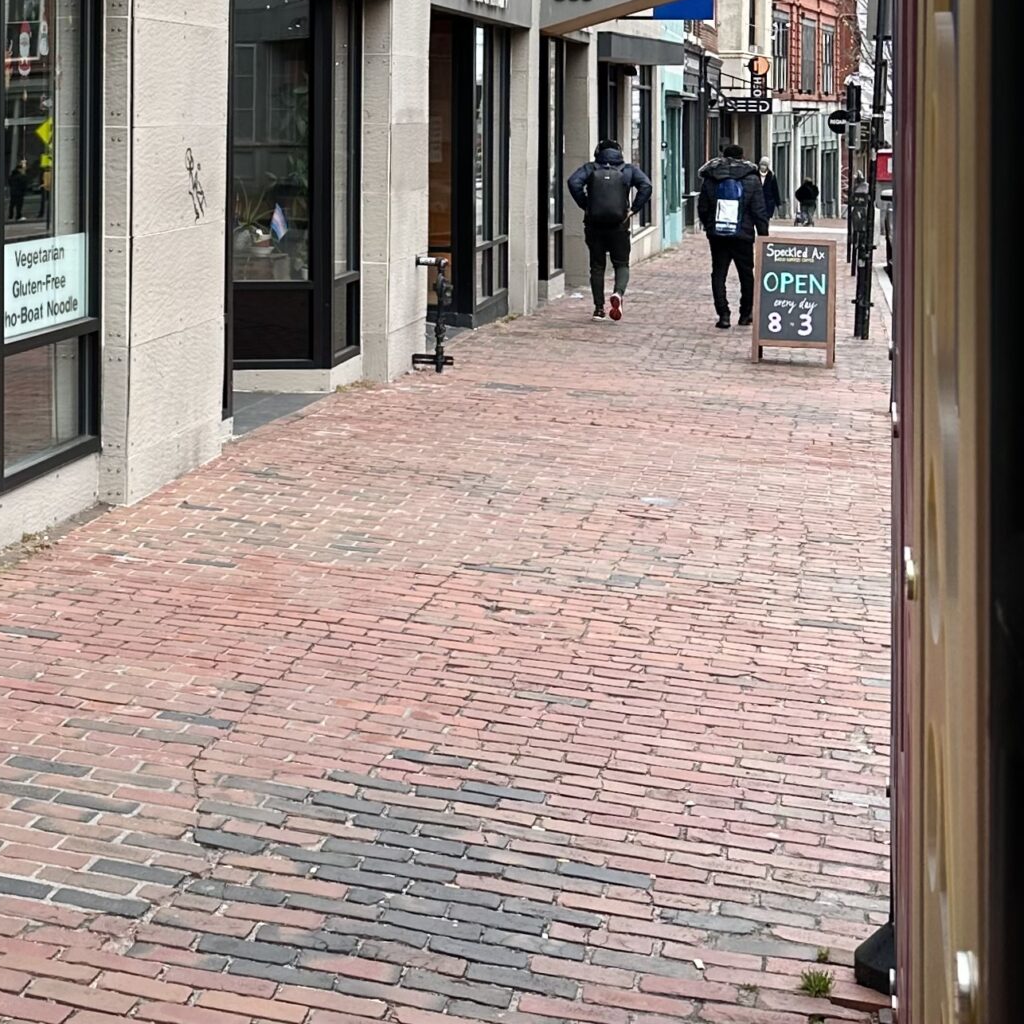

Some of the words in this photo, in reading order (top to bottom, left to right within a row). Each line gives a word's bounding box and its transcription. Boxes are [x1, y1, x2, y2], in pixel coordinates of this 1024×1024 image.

[726, 100, 770, 112] SEED
[14, 245, 65, 269] Vegetarian
[766, 243, 808, 262] Speckled
[812, 247, 825, 260] Ax
[12, 274, 66, 299] Gluten-Free
[763, 271, 826, 295] OPEN
[47, 296, 78, 318] Noodle
[773, 299, 797, 314] every
[798, 297, 818, 316] day
